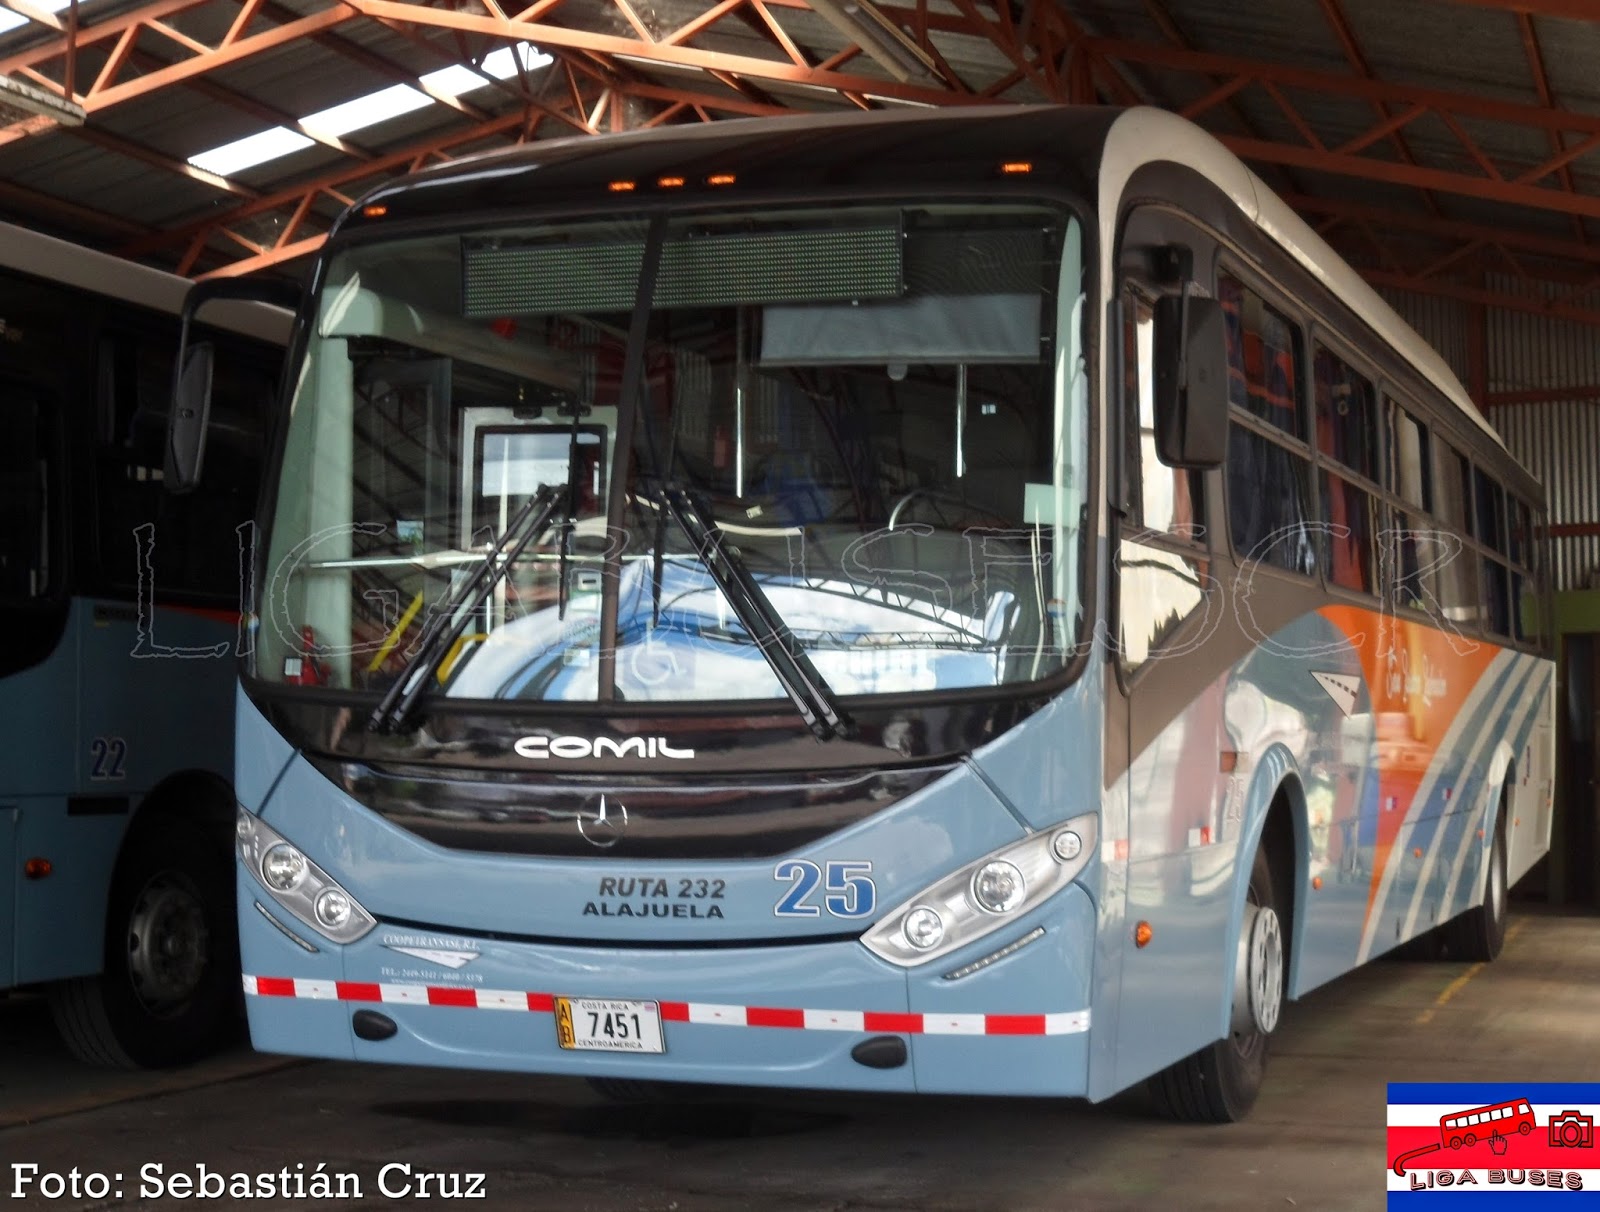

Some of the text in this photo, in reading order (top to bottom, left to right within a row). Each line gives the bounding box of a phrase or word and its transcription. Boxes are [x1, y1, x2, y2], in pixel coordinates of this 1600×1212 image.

[90, 737, 127, 781] 22
[513, 735, 696, 760] COMIL
[598, 876, 726, 900] RUTA 232
[772, 858, 878, 920] 25
[582, 900, 725, 920] ALAJUELA
[581, 1001, 630, 1011] COSTA RICA
[586, 1011, 642, 1040] 7451
[577, 1039, 644, 1050] CENTROAMERICA
